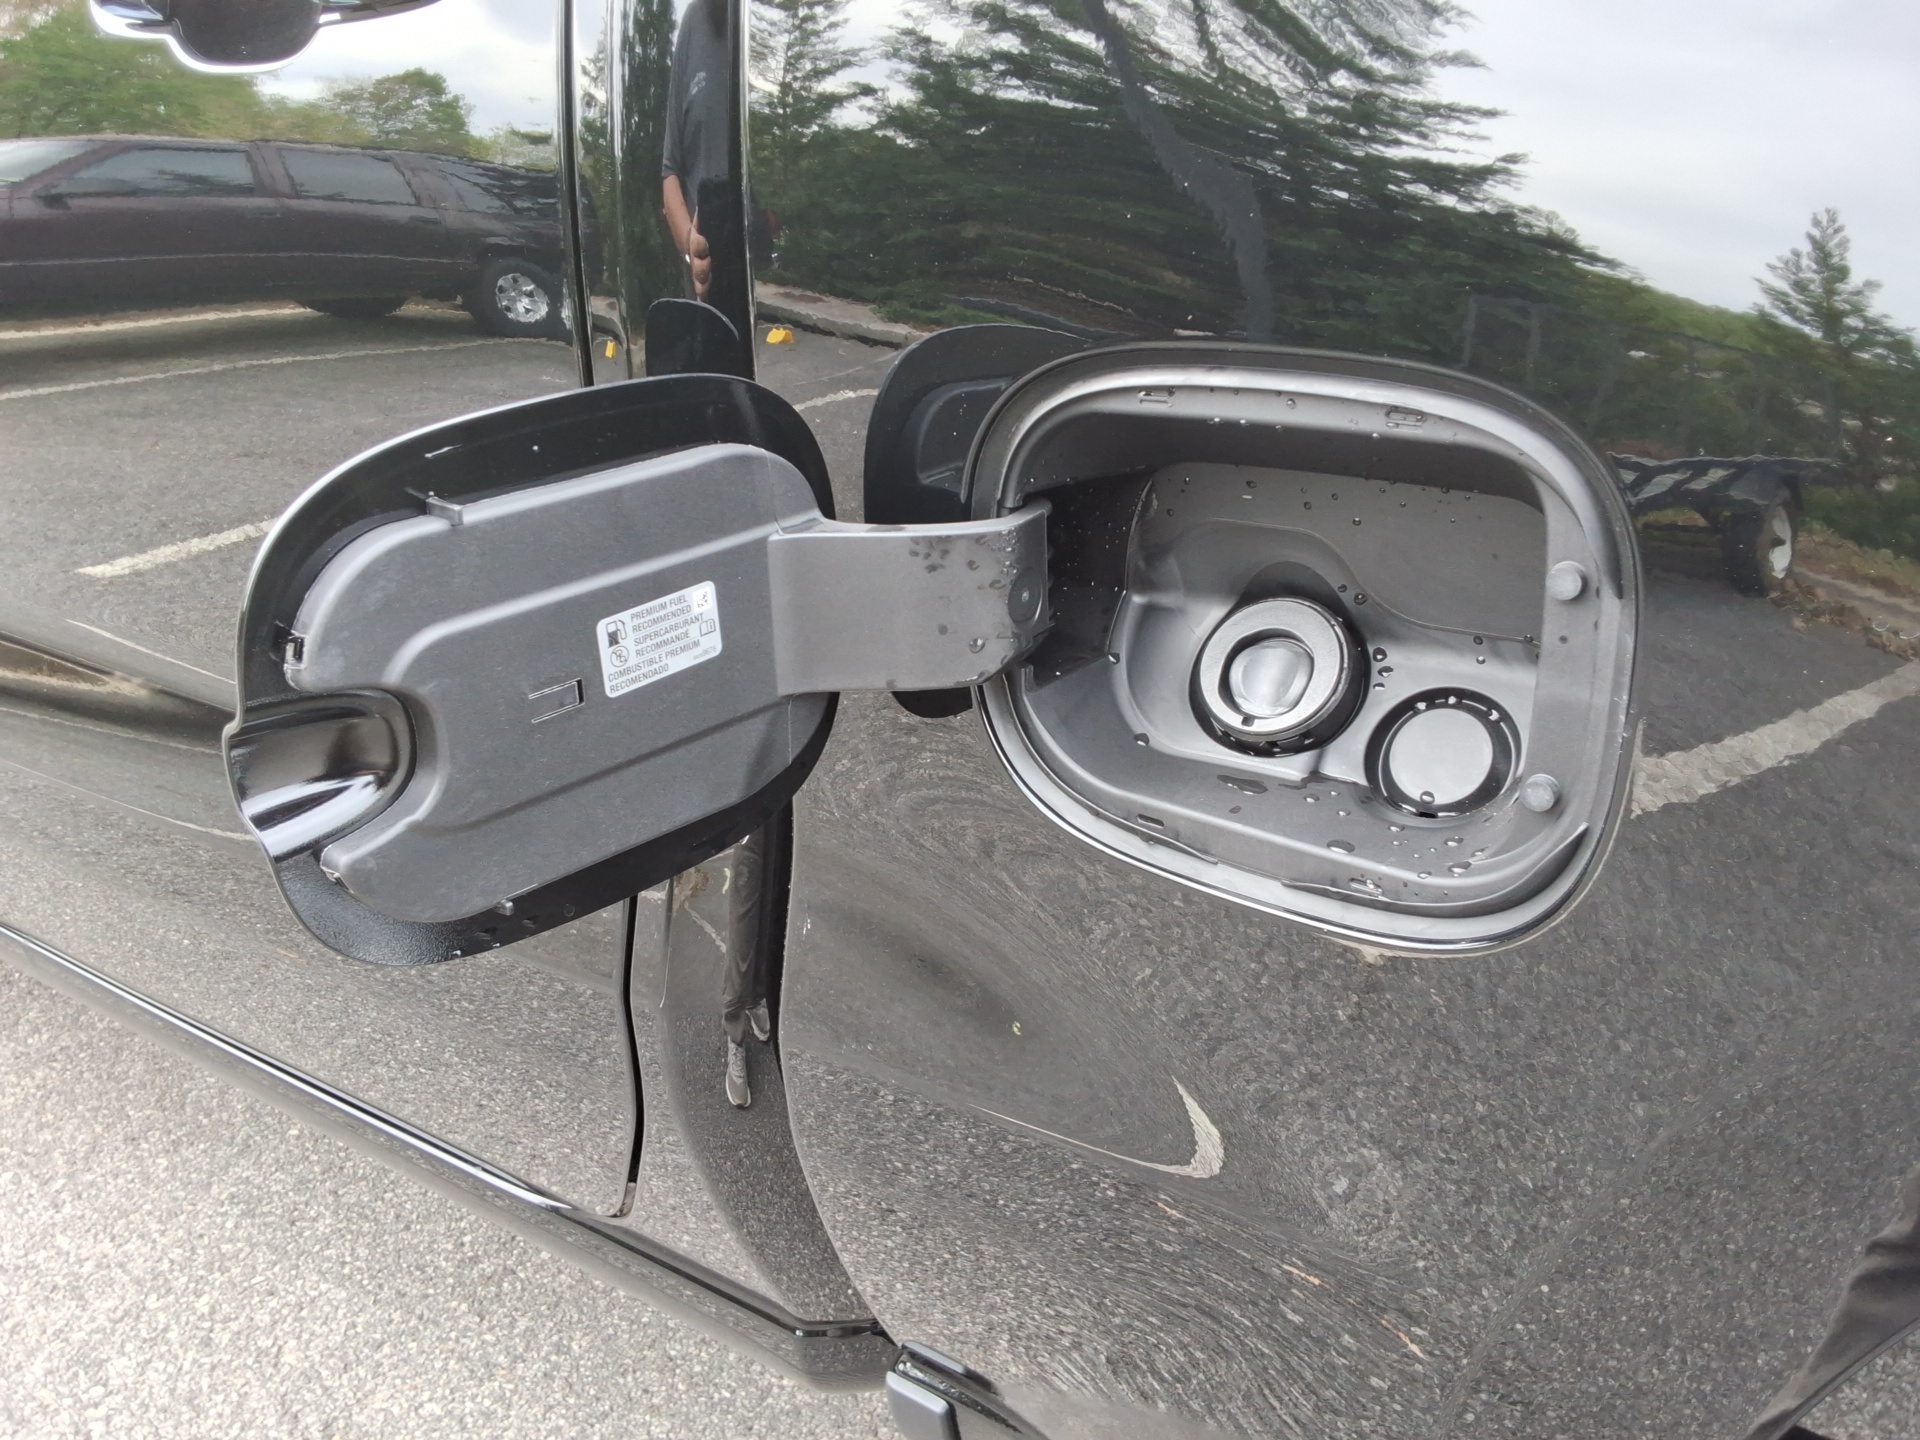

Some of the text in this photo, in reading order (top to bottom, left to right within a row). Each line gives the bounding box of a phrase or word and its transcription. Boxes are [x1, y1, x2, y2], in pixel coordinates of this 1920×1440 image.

[630, 594, 688, 622] PREMIUM FUEL
[632, 604, 692, 634] RECOMMENDED
[633, 613, 705, 647] SUPERCARBURANT
[635, 630, 691, 658] RECOMMANDÉ
[608, 654, 663, 683] COMBUSTIBLE
[665, 639, 701, 660] PREMIUM
[609, 663, 670, 694] RECOMENDADO
